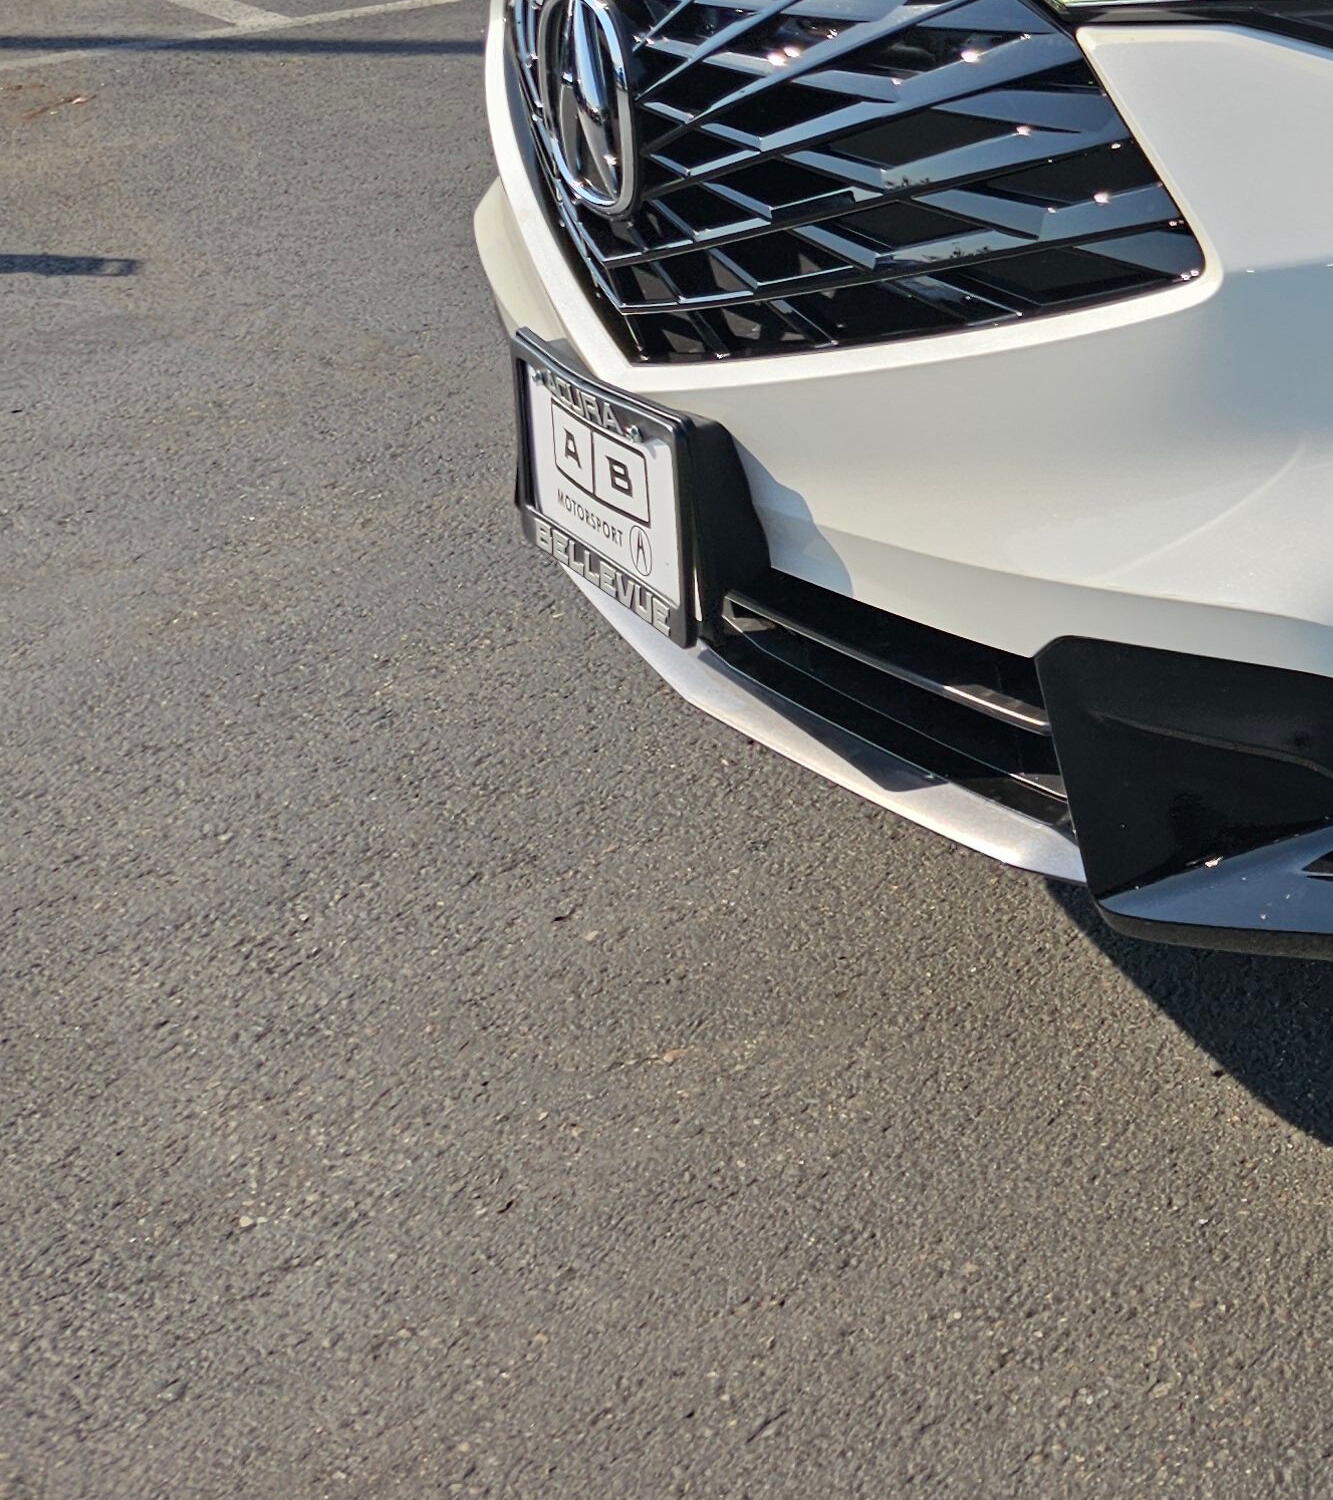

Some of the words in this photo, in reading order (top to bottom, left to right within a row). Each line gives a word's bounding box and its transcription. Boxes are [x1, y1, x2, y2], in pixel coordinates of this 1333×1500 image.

[547, 369, 624, 435] ACURA
[564, 427, 582, 469] A
[606, 455, 633, 497] B
[557, 488, 624, 548] MOTORSPORT
[535, 524, 671, 637] BELLEVUE
